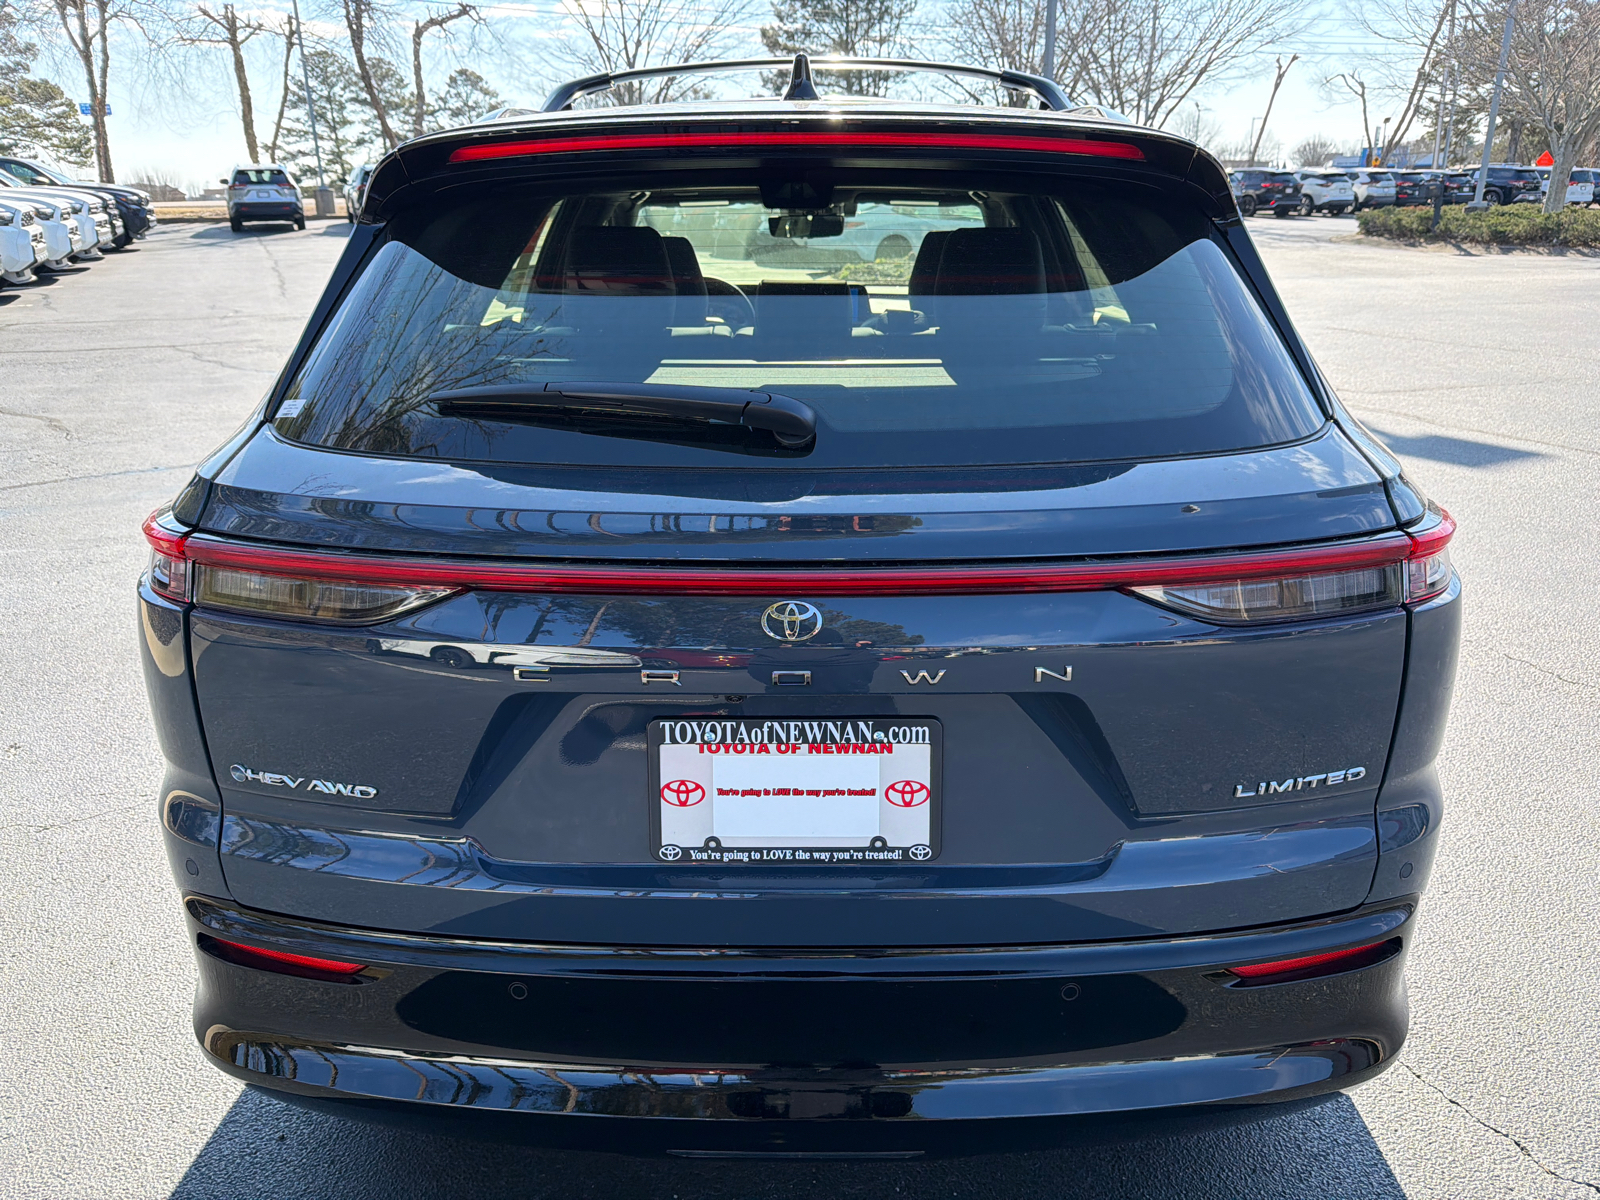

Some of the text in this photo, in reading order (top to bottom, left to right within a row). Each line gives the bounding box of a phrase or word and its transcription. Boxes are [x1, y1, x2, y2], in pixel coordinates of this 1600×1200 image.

[513, 665, 1074, 687] CROWN
[698, 743, 894, 754] TOYOTA OF NEWNAN
[246, 768, 377, 799] HEV AWD
[1234, 766, 1367, 798] LIMITED
[716, 788, 876, 797] You're going to LOVE the way you're treated!
[690, 850, 903, 862] You're going to LOVE the way you're treated!
